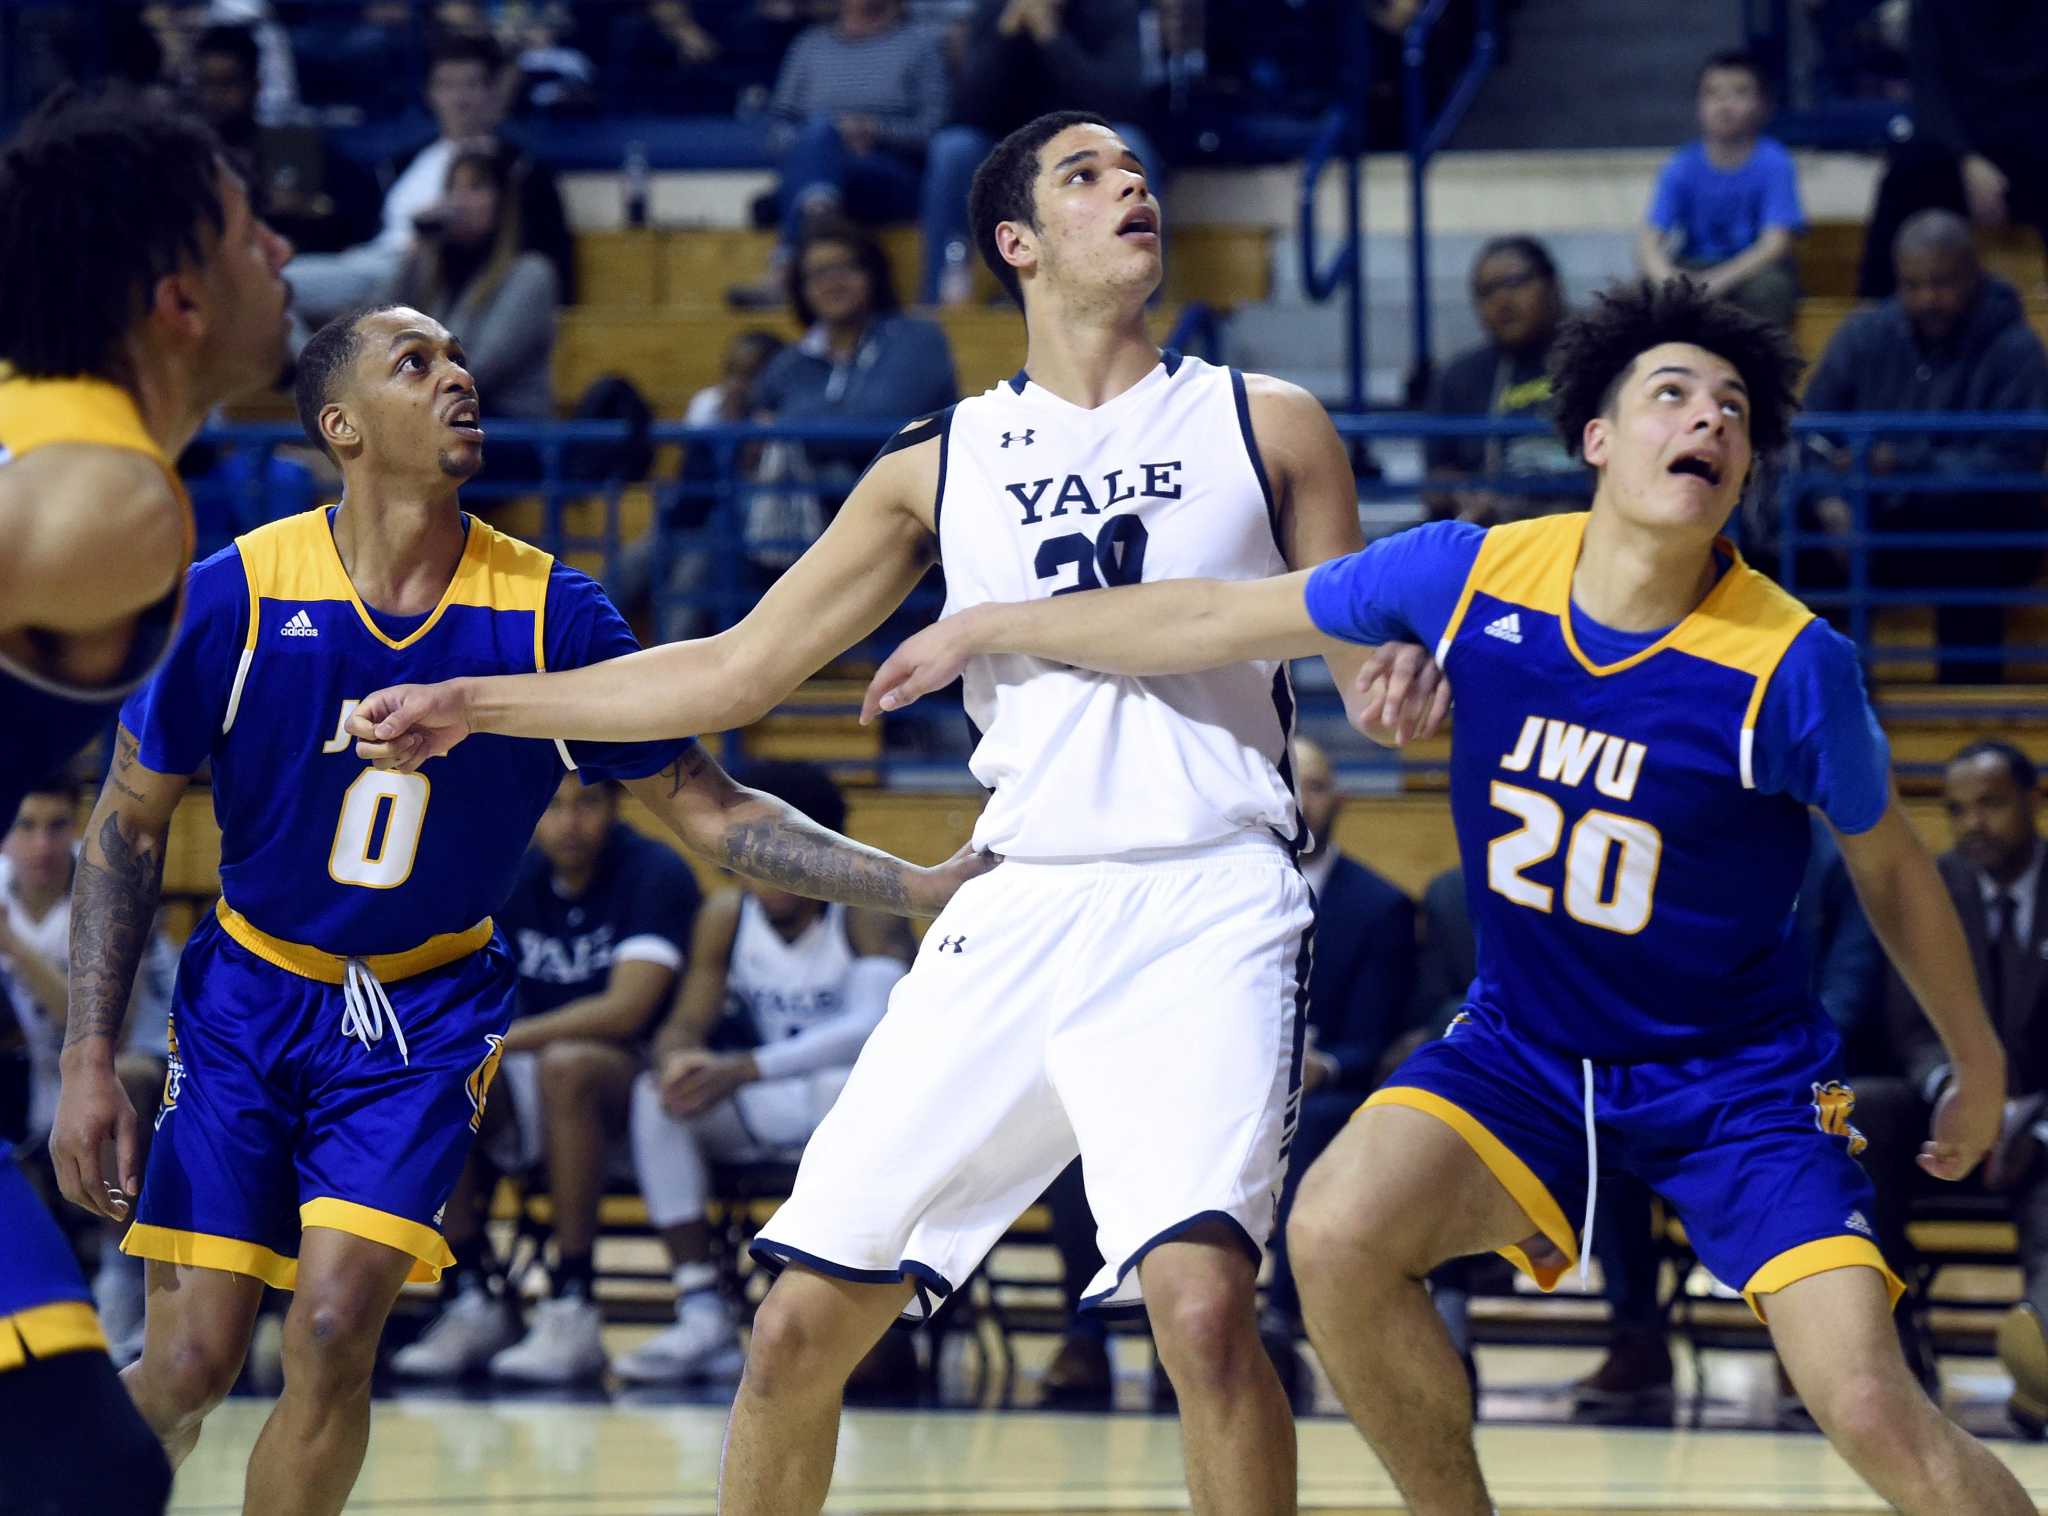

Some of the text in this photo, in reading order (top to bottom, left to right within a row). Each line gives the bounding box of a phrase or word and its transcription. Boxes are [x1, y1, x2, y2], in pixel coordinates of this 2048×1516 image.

[1005, 460, 1182, 526] YALE
[280, 626, 319, 637] adidas
[1500, 715, 1649, 802] JWU
[327, 765, 431, 889] 0
[1487, 778, 1663, 936] 20
